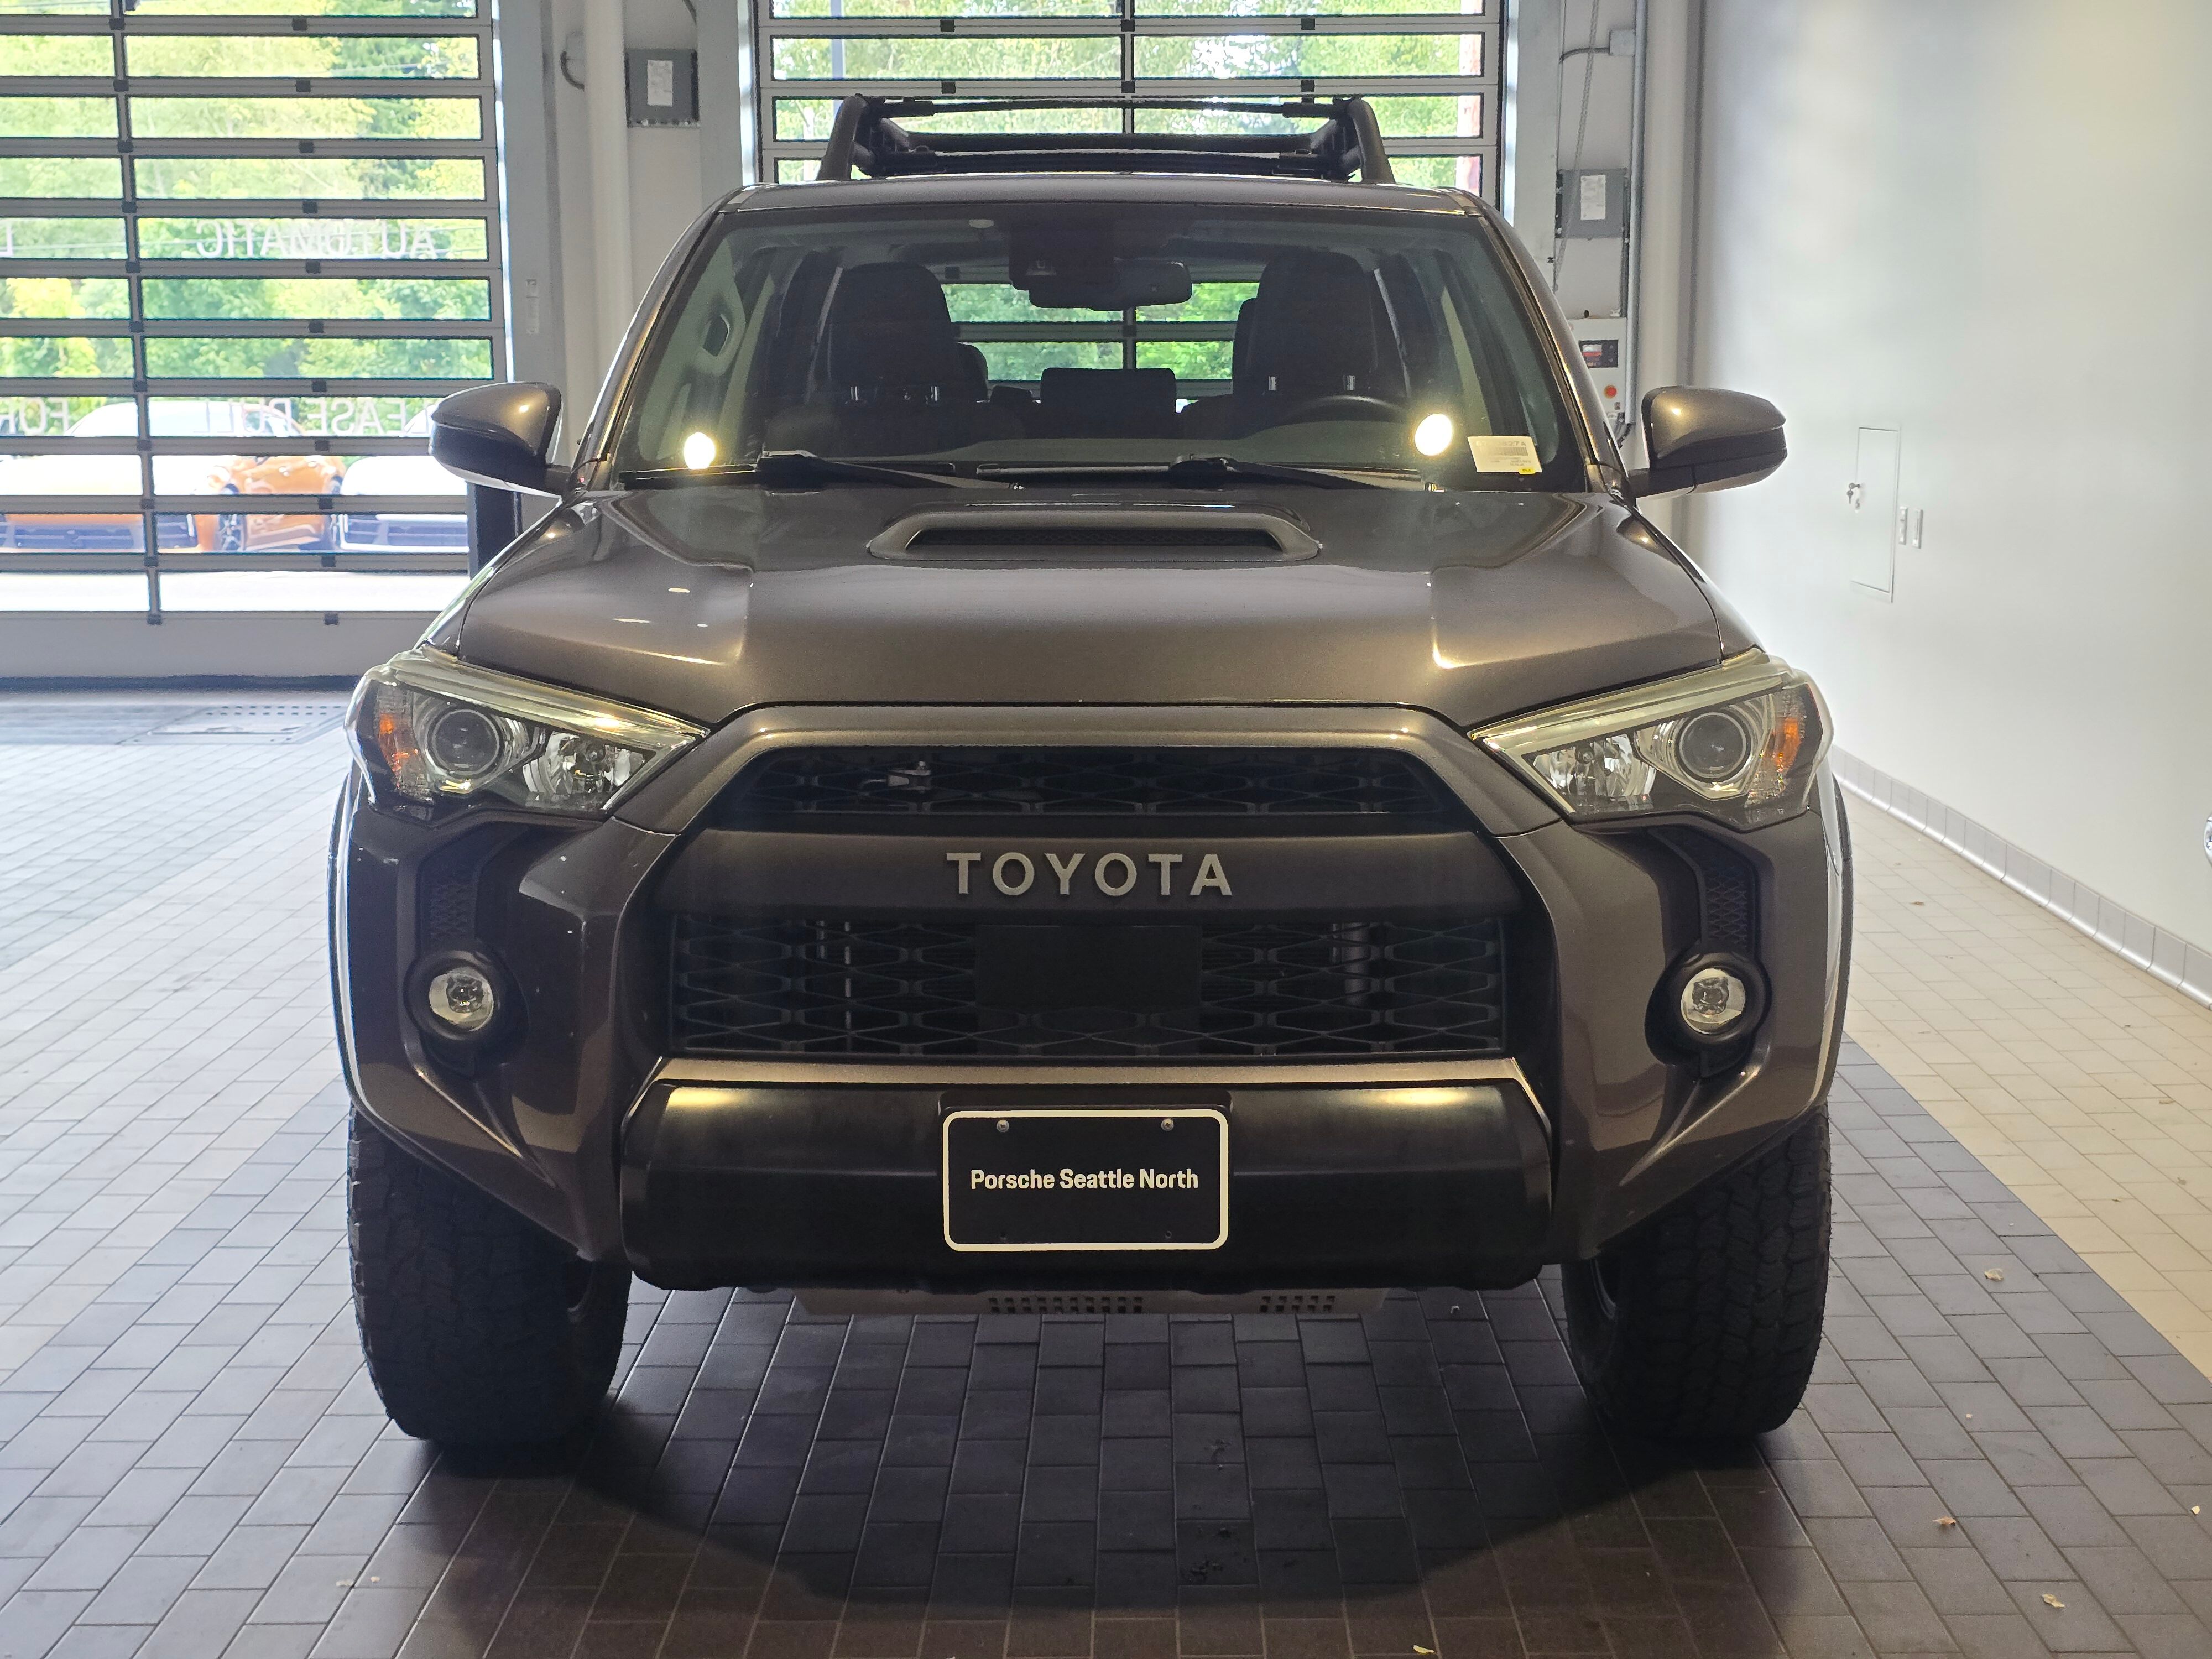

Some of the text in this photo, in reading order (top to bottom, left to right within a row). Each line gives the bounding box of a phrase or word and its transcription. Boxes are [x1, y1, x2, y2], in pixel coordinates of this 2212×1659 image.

[946, 852, 1233, 896] TOYOTA
[971, 1168, 1199, 1190] Porsche Seattle North
